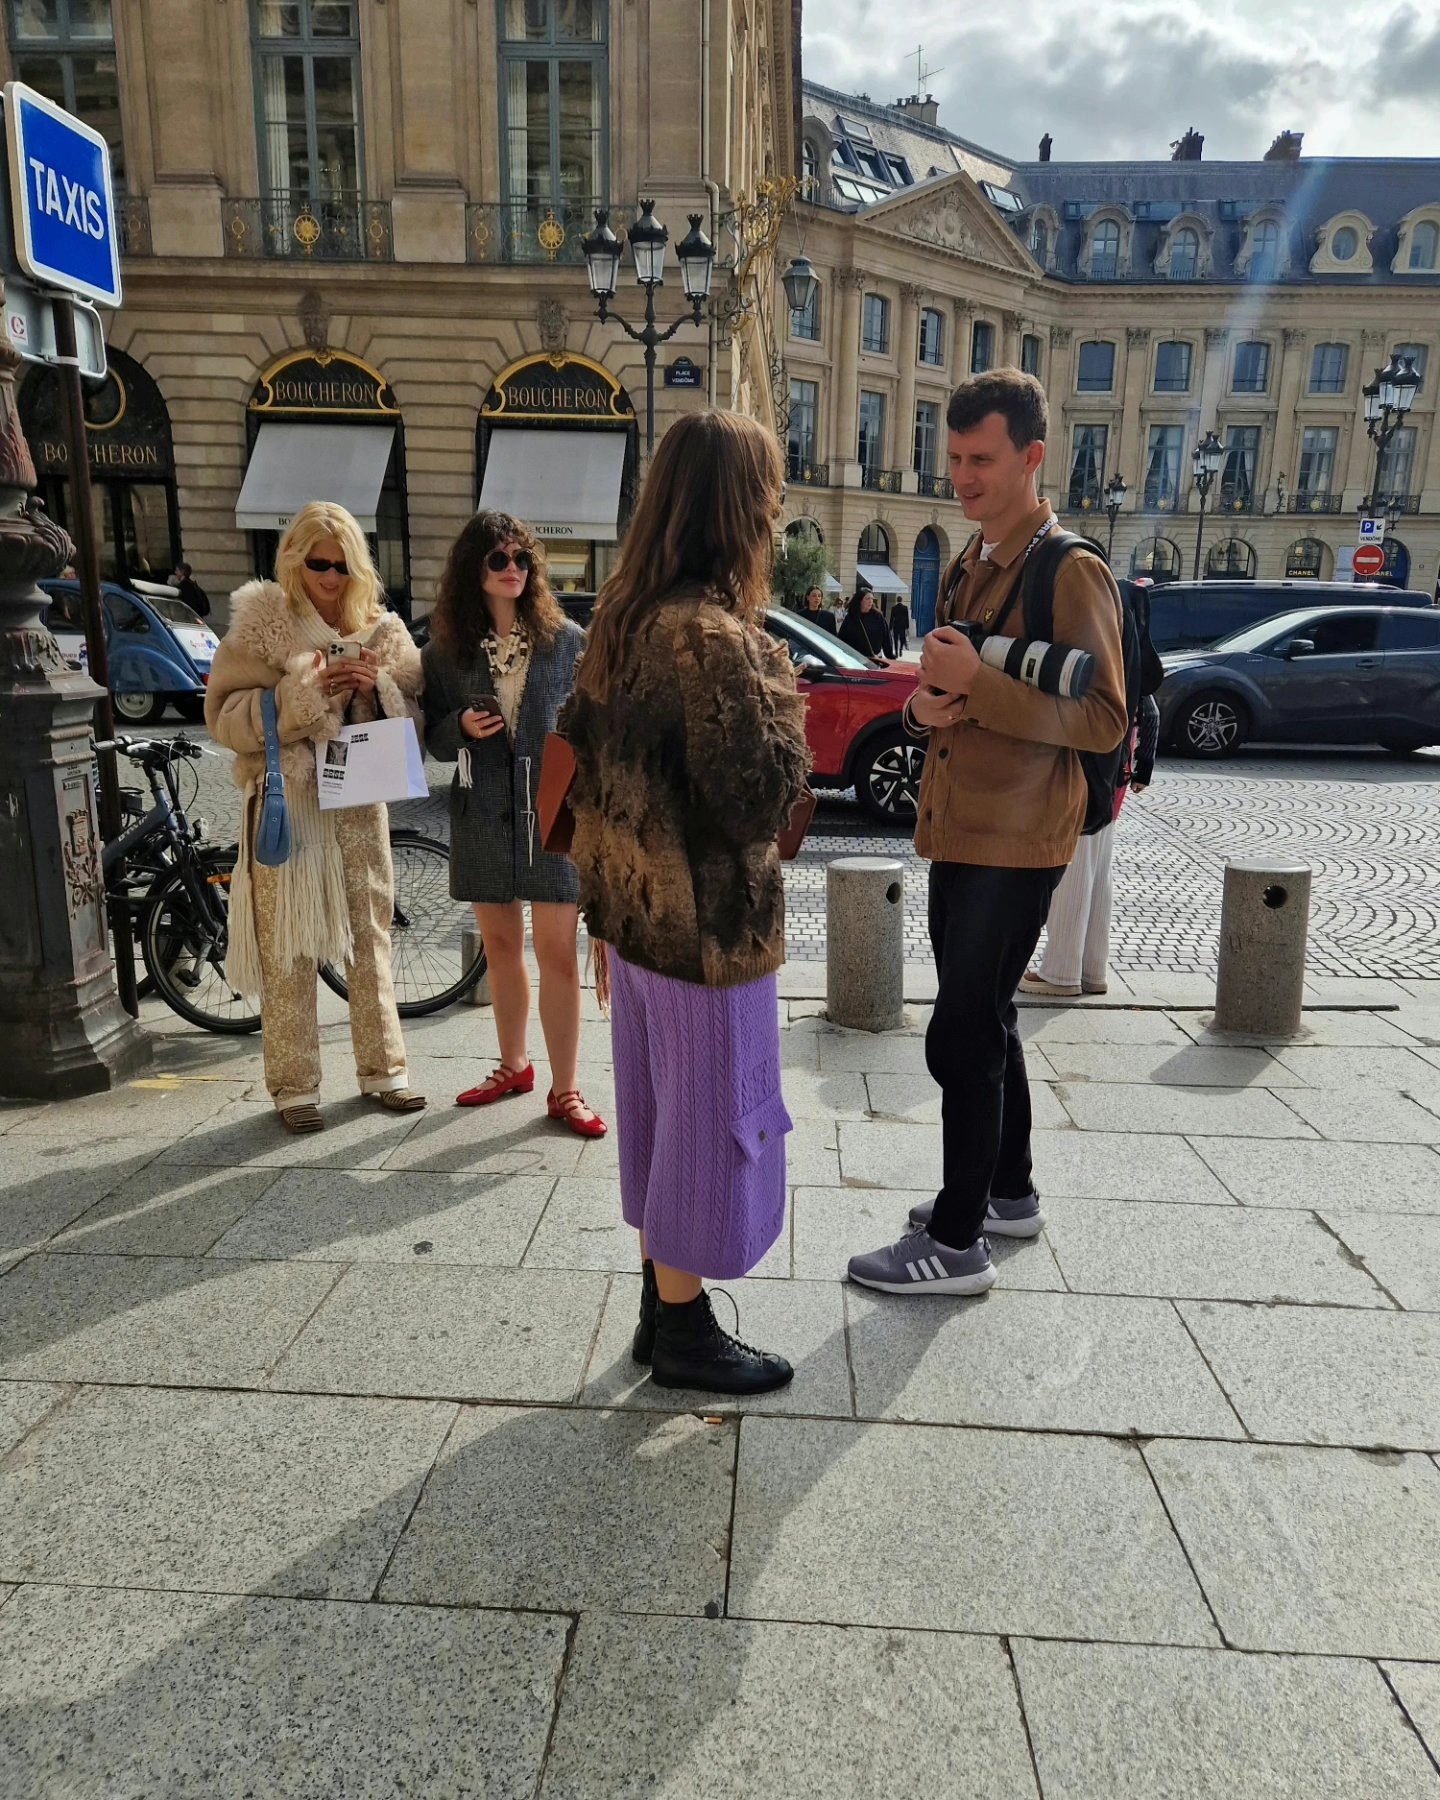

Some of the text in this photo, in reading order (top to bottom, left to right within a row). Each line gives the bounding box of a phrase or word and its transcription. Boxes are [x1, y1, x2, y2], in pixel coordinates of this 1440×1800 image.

[29, 156, 105, 241] TAXIS
[275, 381, 375, 402] BOUCHERON
[508, 386, 607, 408] BOUCHERON
[44, 441, 158, 465] BOHERON
[535, 525, 573, 535] CHERON
[1364, 522, 1372, 532] P
